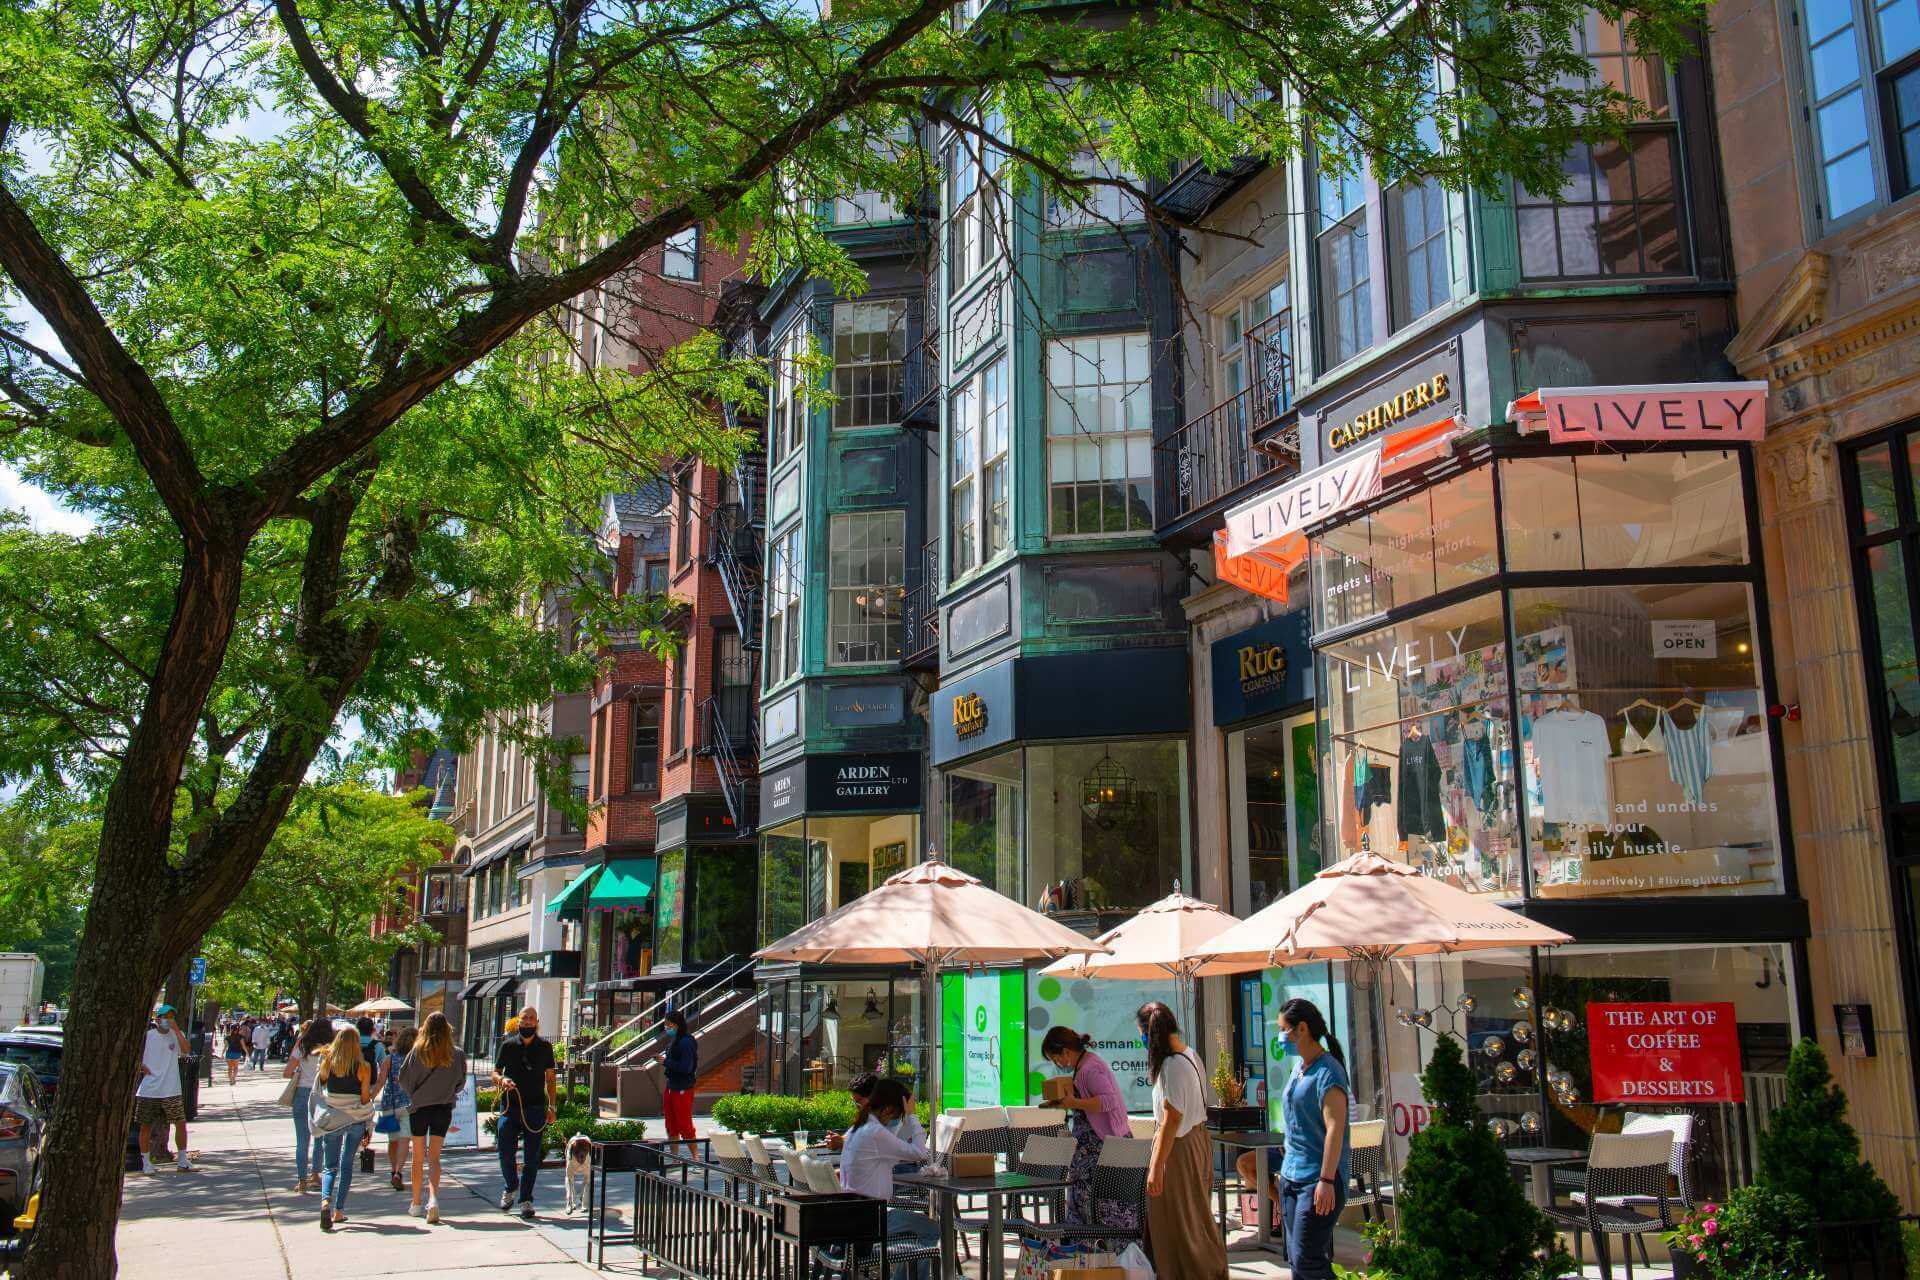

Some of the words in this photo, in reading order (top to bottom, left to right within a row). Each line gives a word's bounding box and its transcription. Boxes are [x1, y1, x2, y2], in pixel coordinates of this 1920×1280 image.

[1328, 373, 1450, 451] CASHMERE
[1557, 398, 1752, 432] LIVELY
[1251, 470, 1347, 540] LIVELY
[1327, 576, 1361, 597] meets
[1663, 638, 1705, 648] OPEN
[1345, 624, 1467, 693] LIVELY
[837, 766, 891, 780] ARDEN
[836, 786, 890, 796] GALLERY
[1615, 800, 1648, 813] and
[1656, 800, 1718, 812] undies
[1604, 822, 1645, 836] your
[1623, 841, 1688, 854] hustle.
[1420, 864, 1464, 879] ly.com
[1577, 875, 1645, 887] wearlively
[1605, 1011, 1645, 1026] THE
[1650, 1011, 1687, 1025] ART
[1692, 1010, 1717, 1025] OF
[1086, 1039, 1147, 1049] osmanb
[1627, 1034, 1701, 1049] COFFEE
[1659, 1057, 1673, 1072] &
[1137, 1076, 1152, 1087] SO
[1622, 1080, 1715, 1097] DESSERTS
[1392, 1102, 1440, 1137] OP
